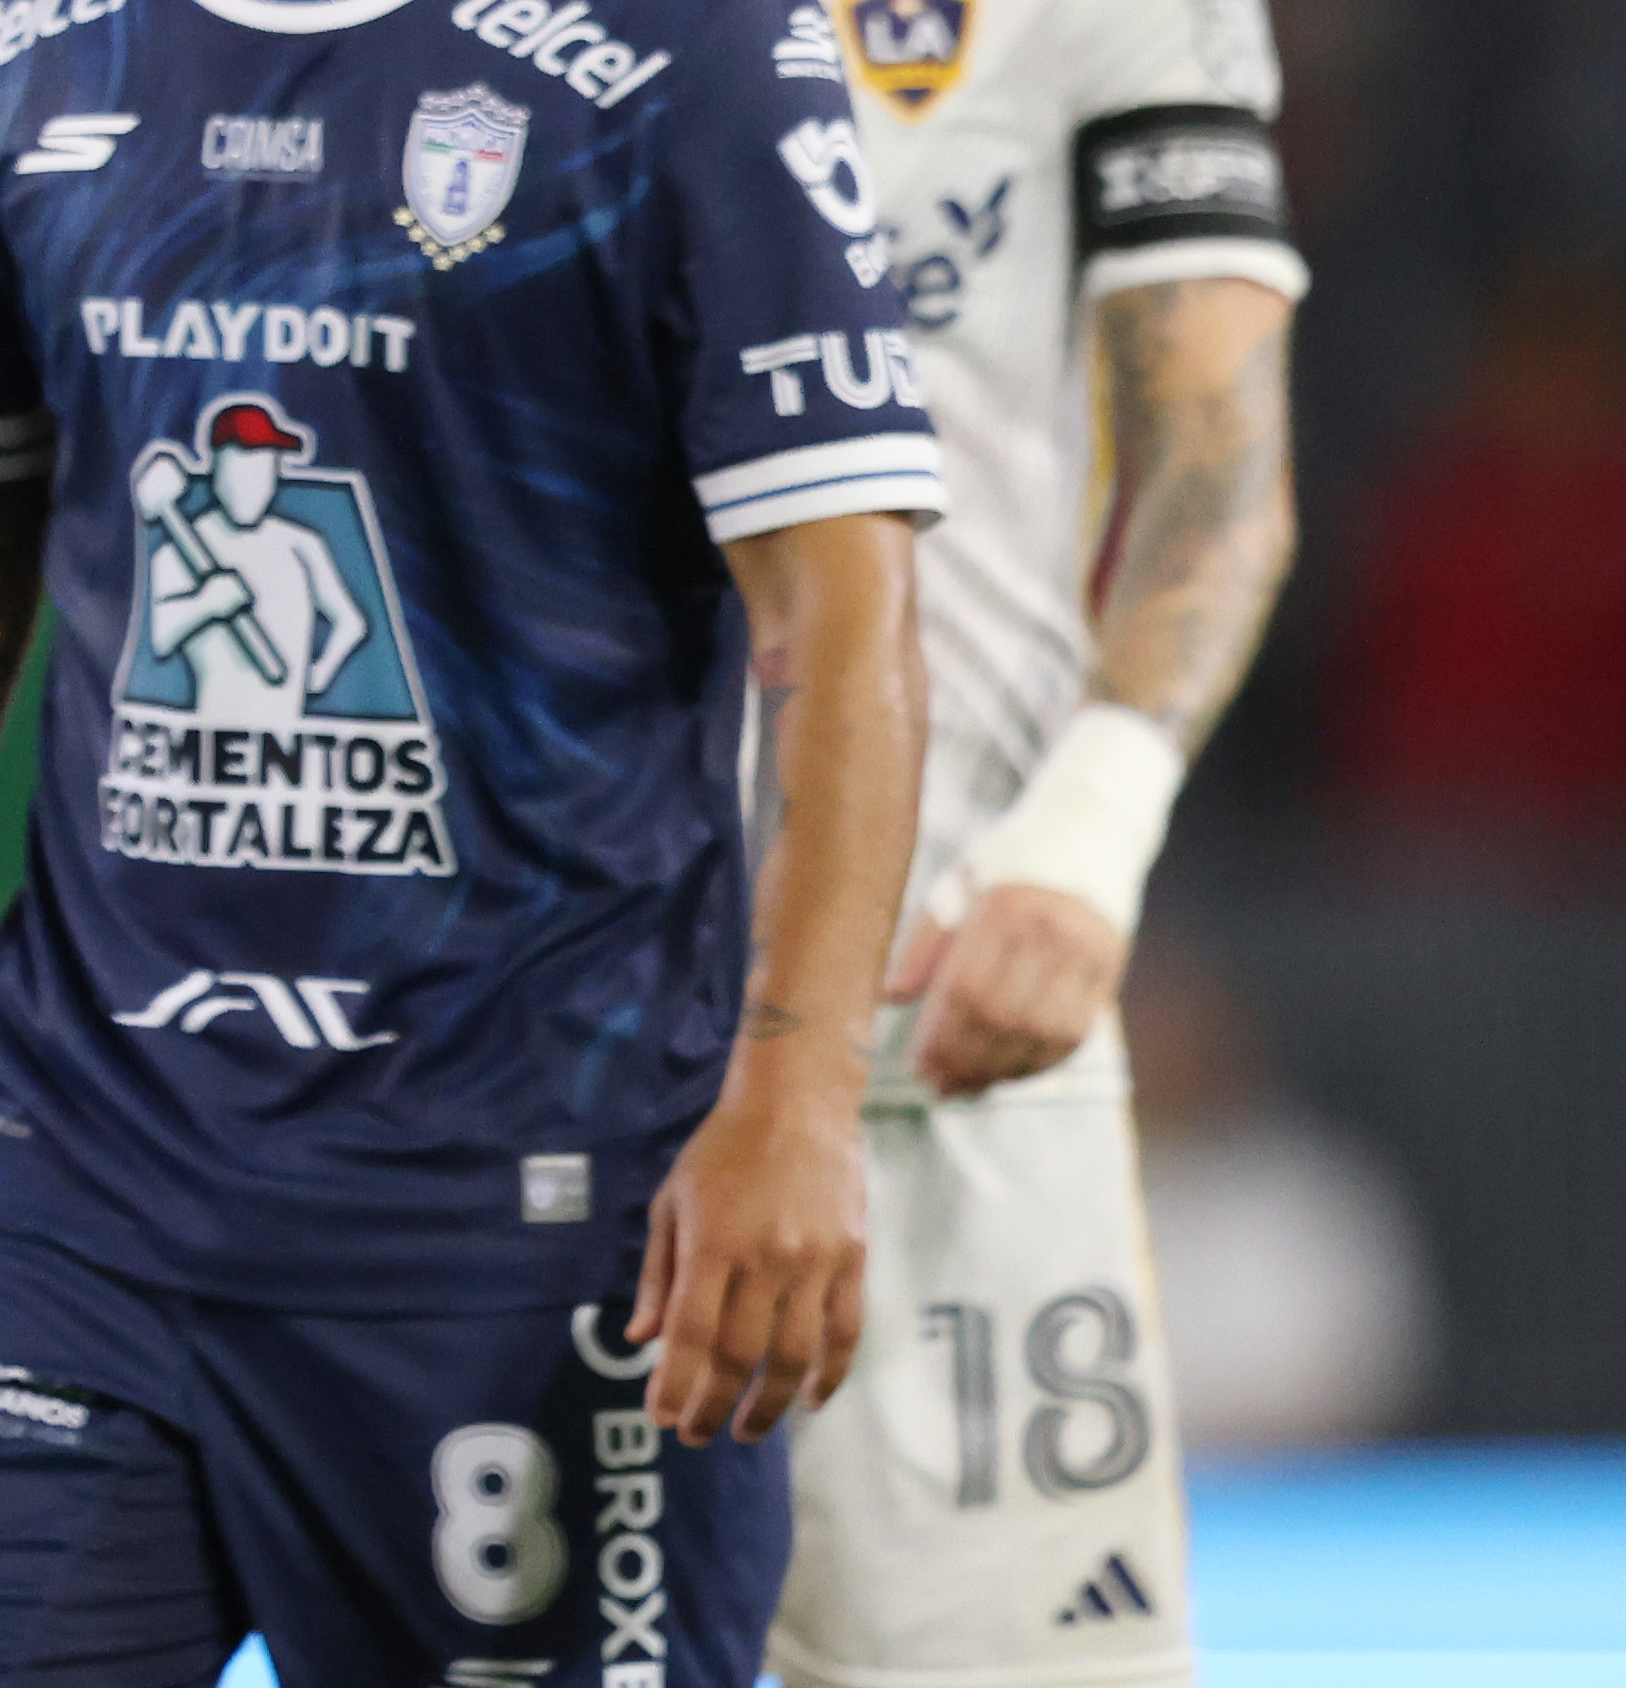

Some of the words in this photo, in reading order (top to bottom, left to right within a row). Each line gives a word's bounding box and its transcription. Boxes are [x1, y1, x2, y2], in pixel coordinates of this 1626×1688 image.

[81, 296, 415, 372] PLAYDOIT
[920, 1284, 1151, 1507] 18
[431, 1423, 570, 1626] 8
